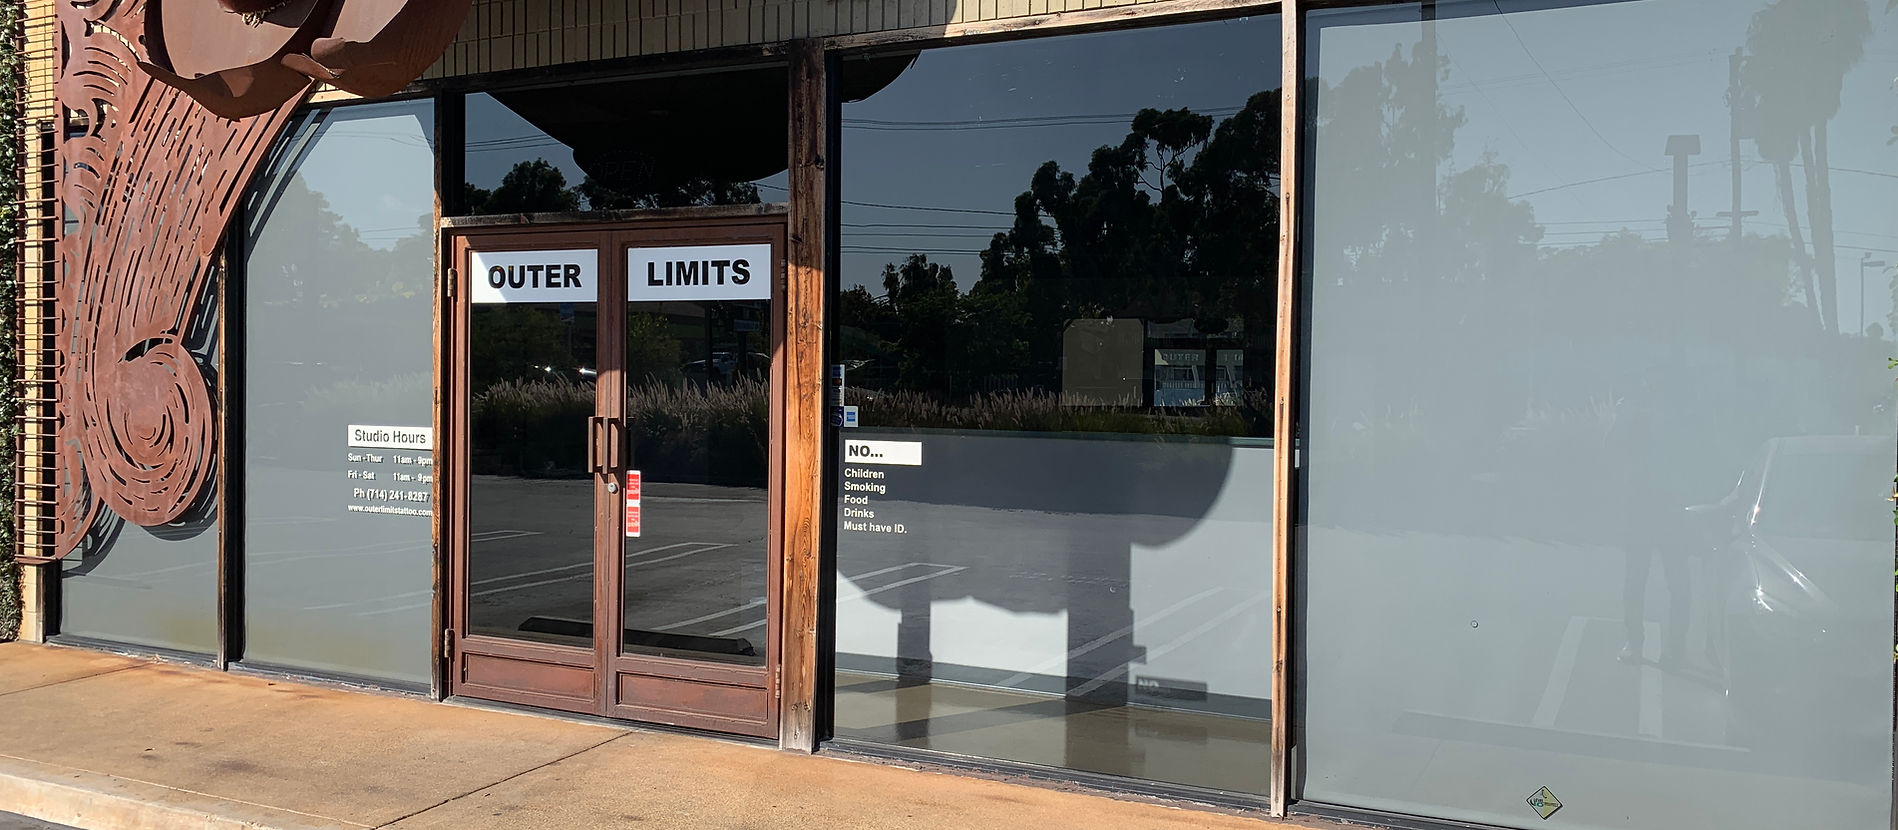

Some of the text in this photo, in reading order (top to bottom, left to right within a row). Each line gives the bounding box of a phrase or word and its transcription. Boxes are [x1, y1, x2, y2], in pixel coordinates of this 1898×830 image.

[488, 258, 751, 289] OUTER LIMITS
[354, 429, 426, 444] Studio Hours
[848, 445, 884, 458] NO...
[844, 468, 885, 479] Children
[844, 481, 886, 495] Smoking
[353, 488, 429, 502] Ph (714) 241-8287
[844, 494, 868, 505] Food
[347, 505, 433, 516] www.outerlimitstattoo.com
[844, 507, 875, 519] Drinks
[843, 520, 908, 534] Must have ID.
